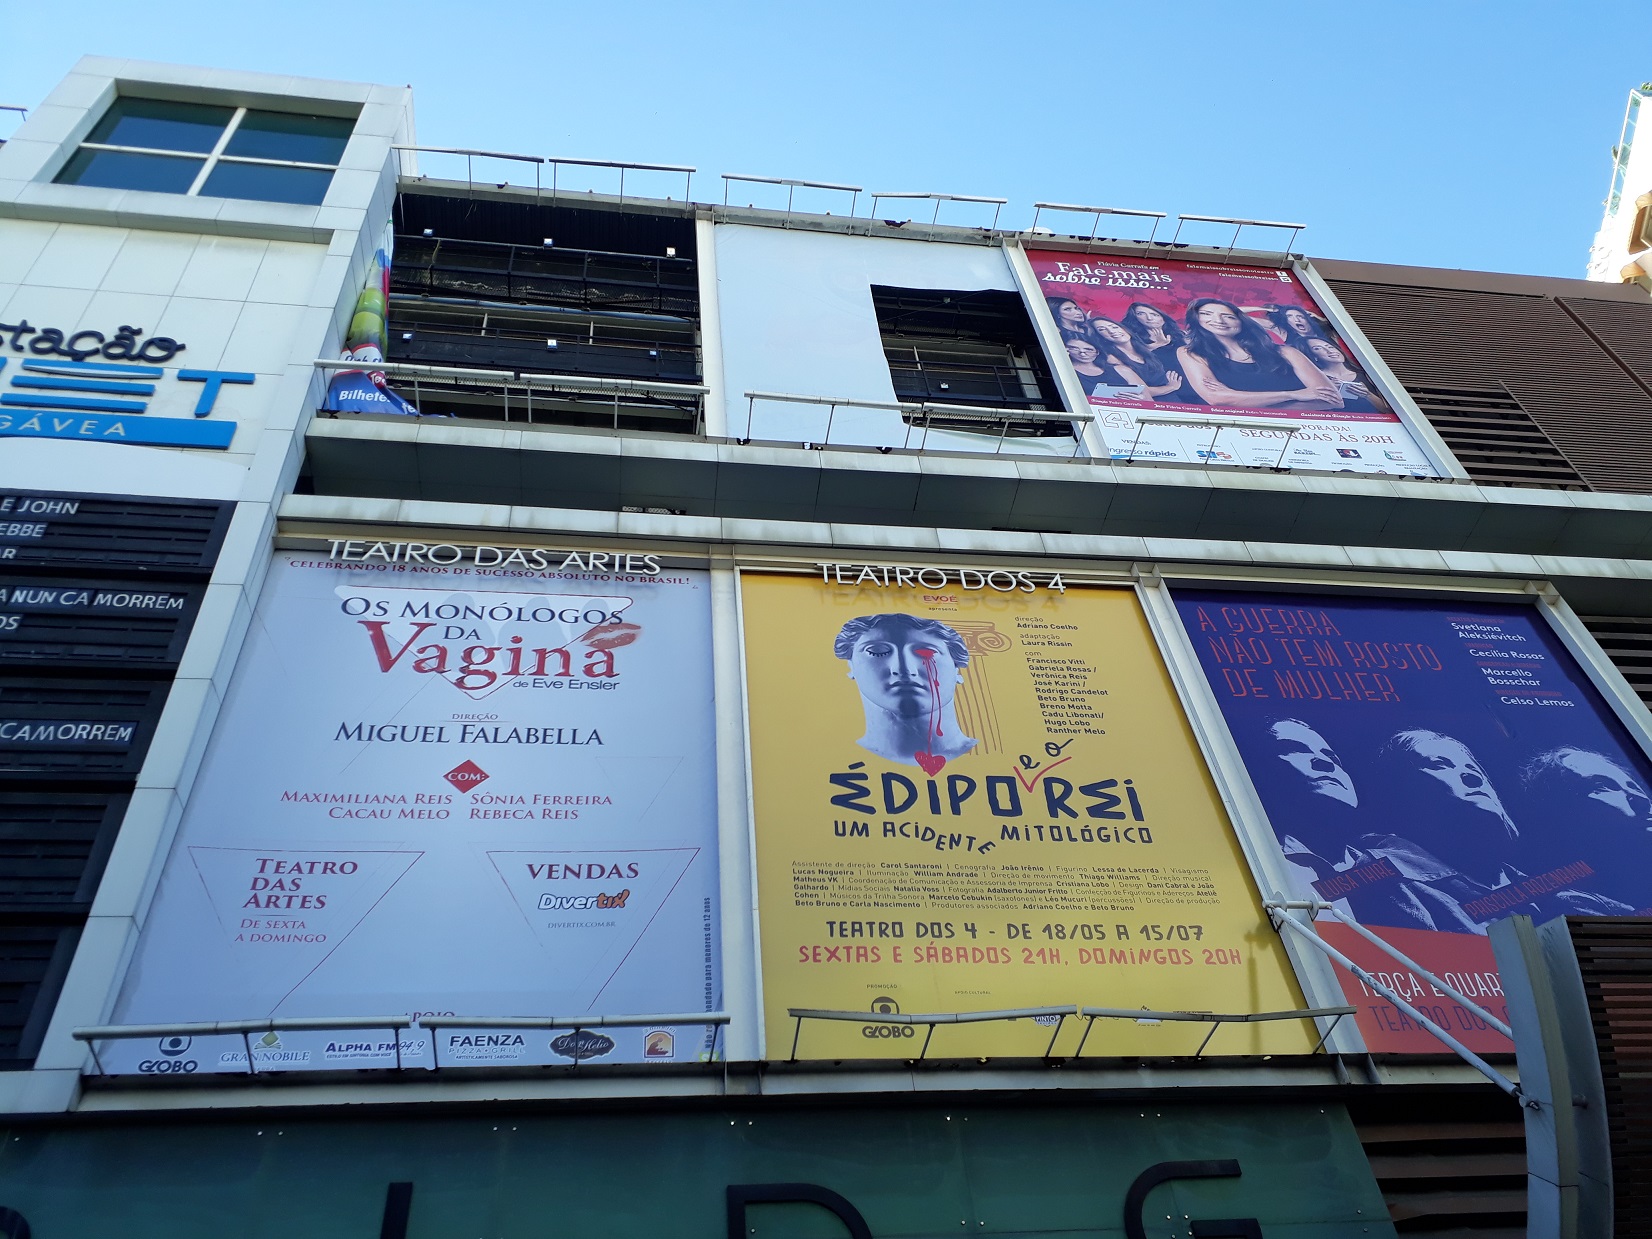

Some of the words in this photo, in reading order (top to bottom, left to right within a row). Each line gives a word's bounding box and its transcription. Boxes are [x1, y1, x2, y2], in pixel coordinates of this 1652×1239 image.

[1055, 262, 1107, 277] Fale
[1110, 269, 1173, 283] mais
[1042, 271, 1101, 286] sobre
[1106, 274, 1168, 290] isso...
[0, 319, 185, 361] tação
[1239, 428, 1332, 442] SEGUNDAS
[1338, 431, 1359, 443] ÀS
[1362, 434, 1395, 444] 20H
[1144, 448, 1177, 458] rápido
[17, 500, 79, 514] JOHN
[328, 539, 463, 565] TEATRO
[475, 546, 549, 571] DAS
[558, 550, 663, 576] ARTES
[289, 560, 388, 573] CELEBRANDO
[392, 564, 406, 573] 18
[409, 566, 449, 575] ANOS
[453, 568, 472, 576] DE
[475, 569, 535, 578] SUCESSO
[539, 572, 611, 582] ABSOLUTO
[615, 575, 636, 583] NO
[639, 576, 690, 585] BRASIL!
[817, 563, 948, 590] TEATRO
[959, 569, 1036, 593] DOS
[1048, 572, 1067, 595] 4
[93, 593, 184, 610] MORREM
[923, 595, 958, 603] EVOÉ
[340, 596, 390, 617] OS
[399, 601, 624, 626] MONÓLOGOS
[1014, 616, 1044, 624] direção
[1017, 622, 1049, 630] Adriano
[1050, 623, 1079, 631] Coelho
[1196, 606, 1218, 632] A
[1220, 607, 1342, 637] GUERRA
[1451, 622, 1502, 632] Svetlana
[443, 625, 482, 641] DA
[1020, 633, 1061, 641] adaptação
[1458, 631, 1527, 642] Aleksiévitch
[357, 620, 621, 691] Vagina
[1208, 633, 1274, 665] NÃO
[1275, 637, 1343, 668] TEM
[1344, 641, 1443, 672] ROSTO
[1469, 648, 1510, 659] Cecília
[1511, 650, 1545, 660] Rosas
[1026, 657, 1067, 665] Francisco
[1068, 658, 1086, 666] Vitti
[1028, 664, 1065, 672] Gabriela
[1030, 672, 1067, 680] Verônica
[1069, 673, 1088, 681] Reis
[1481, 667, 1533, 678] Marcello
[512, 680, 530, 689] de
[532, 678, 564, 690] Eve
[568, 679, 621, 691] Ensler
[1054, 680, 1081, 688] Karini
[1221, 668, 1270, 698] DE
[1272, 670, 1401, 703] MULHER
[1487, 677, 1542, 687] Bosschar
[1035, 687, 1069, 696] Rodrigo
[1070, 688, 1109, 696] Candelot
[1059, 695, 1086, 703] Bruno
[1500, 696, 1534, 706] Celso
[1536, 699, 1575, 707] Lemos
[1039, 702, 1066, 710] Breno
[1067, 703, 1093, 711] Motta
[451, 712, 499, 722] DIREÇÃO
[1044, 718, 1067, 727] Hugo
[1069, 719, 1091, 727] Lobo
[333, 720, 451, 744] MIGUEL
[458, 723, 605, 747] FALABELLA
[1046, 726, 1082, 735] Ranther
[1084, 727, 1106, 735] Melo
[447, 772, 485, 781] COM:
[280, 789, 407, 805] MAXIMILIANA
[414, 793, 453, 806] REIS
[470, 790, 527, 806] SÔNIA
[533, 793, 613, 806] FERREIRA
[328, 806, 393, 820] CACAU
[398, 807, 450, 820] MELO
[468, 808, 535, 821] REBECA
[541, 808, 580, 821] REIS
[833, 820, 871, 838] UM
[255, 858, 359, 875] TEATRO
[525, 861, 640, 880] VENDAS
[818, 868, 855, 876] Nogueira
[249, 877, 303, 892] DAS
[1317, 872, 1360, 899] LUISA
[241, 894, 328, 910] ARTES
[703, 897, 711, 913] anos
[1463, 884, 1529, 920] PRISCILLA
[239, 918, 261, 929] DE
[265, 919, 307, 930] SEXTA
[703, 914, 711, 923] 12
[703, 922, 711, 932] de
[826, 920, 904, 940] TEATRO
[915, 921, 956, 940] DOS
[964, 921, 978, 940] 4
[1006, 923, 1033, 940] DE
[1042, 923, 1107, 941] 18/05
[1116, 924, 1131, 941] A
[1139, 923, 1205, 942] 15/07
[234, 933, 245, 943] A
[249, 933, 327, 944] DOMINGO
[704, 933, 712, 964] menores
[798, 945, 882, 963] SEXTAS
[892, 946, 903, 964] E
[913, 941, 1012, 965] SÁBADOS
[1022, 946, 1070, 966] 21H,
[1202, 948, 1242, 966] 20H
[704, 964, 713, 981] para
[862, 1025, 915, 1039] GLOBO
[325, 1042, 372, 1053] ALPHA
[378, 1043, 396, 1052] FM
[449, 1034, 525, 1047] FAENZA
[262, 1050, 310, 1062] NOBILE
[138, 1060, 199, 1074] GLOBO
